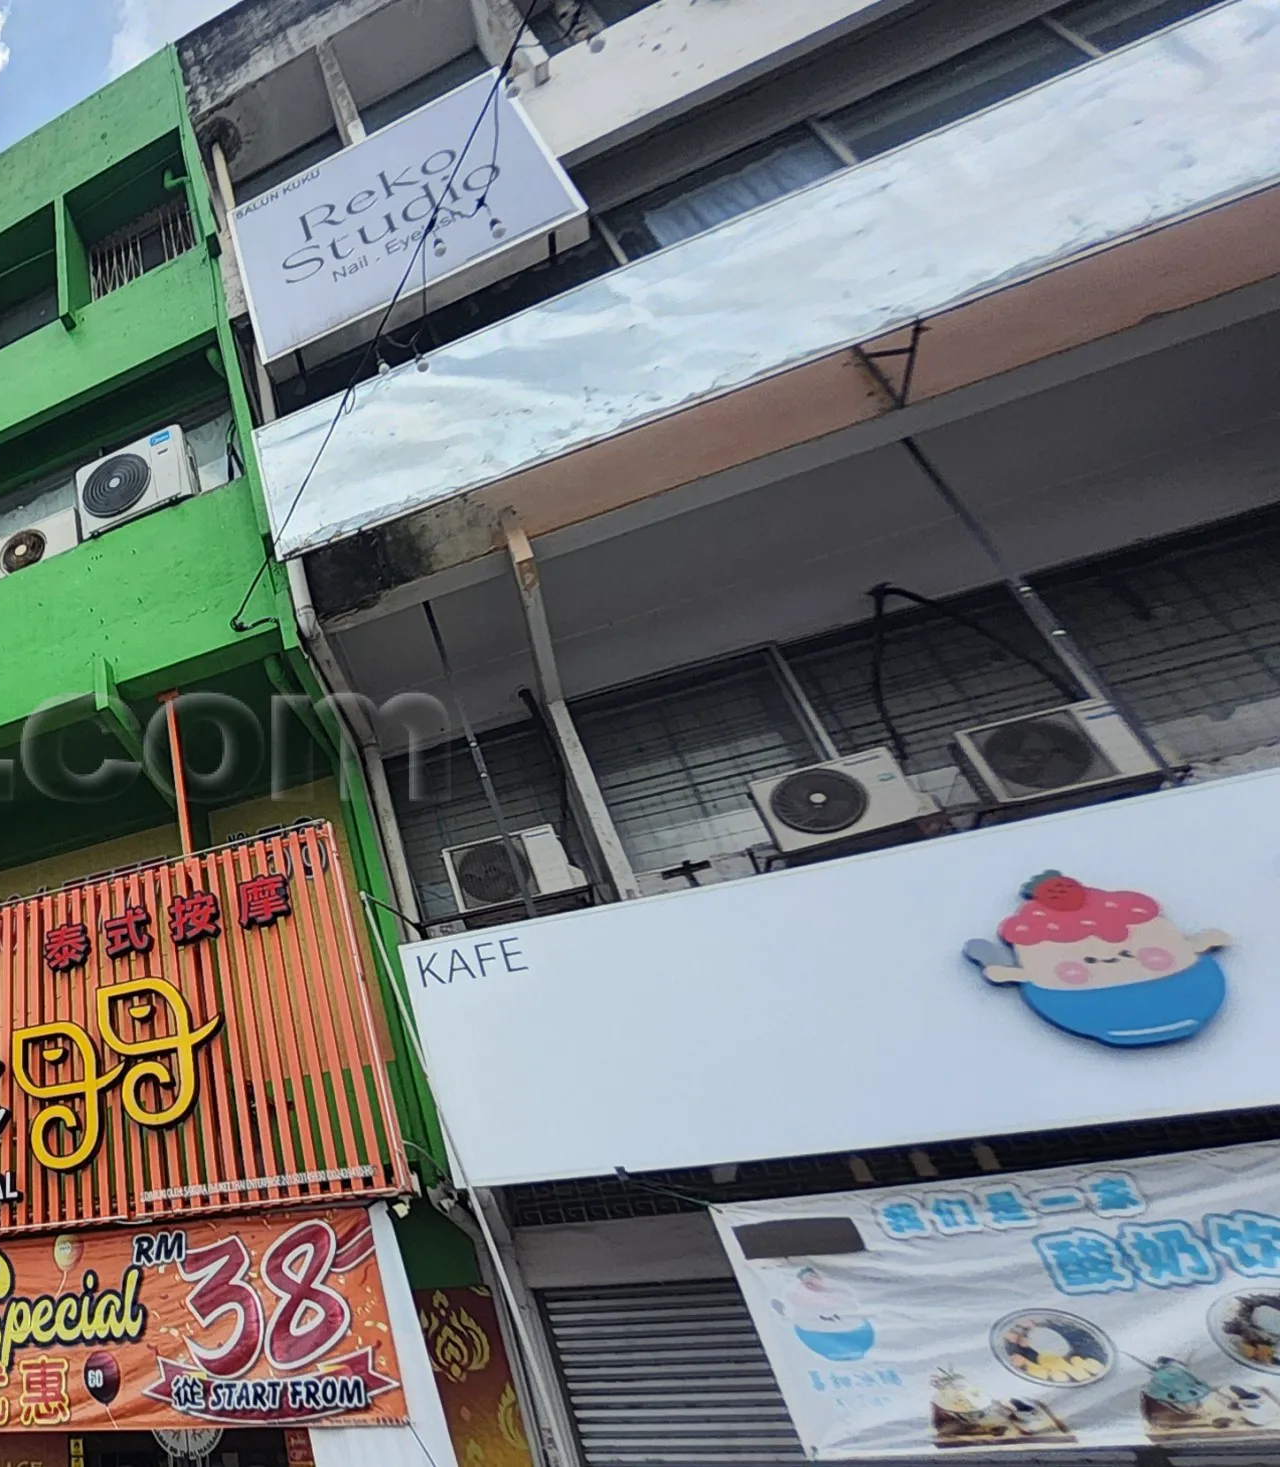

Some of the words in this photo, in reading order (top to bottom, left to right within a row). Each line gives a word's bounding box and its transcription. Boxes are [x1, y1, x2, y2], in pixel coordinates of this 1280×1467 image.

[282, 168, 320, 195] KUKU
[299, 150, 456, 242] Reko
[282, 165, 499, 284] Studio
[332, 255, 369, 282] Nail
[45, 875, 292, 970] 泰式按摩
[416, 937, 529, 988] KAFE
[134, 1231, 186, 1267] RM
[177, 1219, 351, 1379] 38
[88, 1369, 103, 1388] 60
[210, 1380, 282, 1409] START
[289, 1375, 365, 1408] FROM
